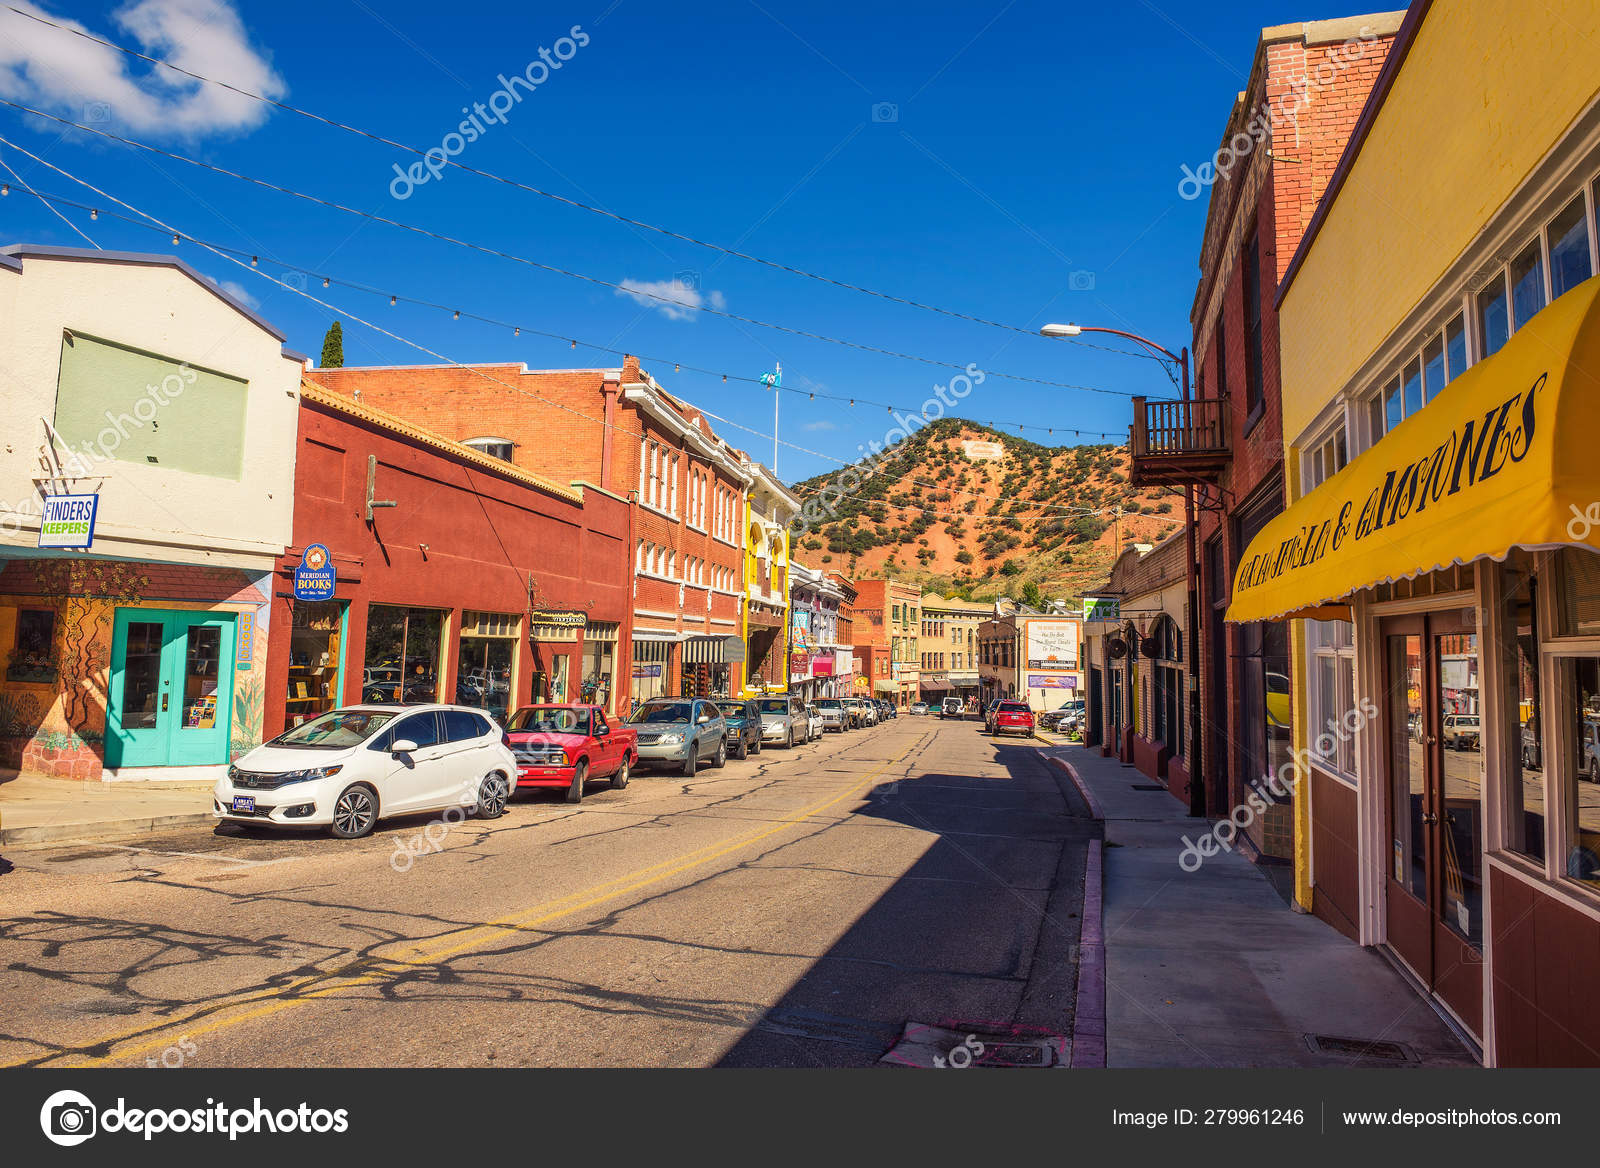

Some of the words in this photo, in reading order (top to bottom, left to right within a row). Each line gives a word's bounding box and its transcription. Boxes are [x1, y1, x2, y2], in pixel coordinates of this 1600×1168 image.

[44, 500, 92, 521] FINDERS
[42, 522, 89, 534] KEEPERS
[1333, 501, 1352, 551] &
[300, 571, 330, 579] MERIDIAN
[297, 579, 332, 590] BOOKS
[241, 614, 251, 659] BOOKS
